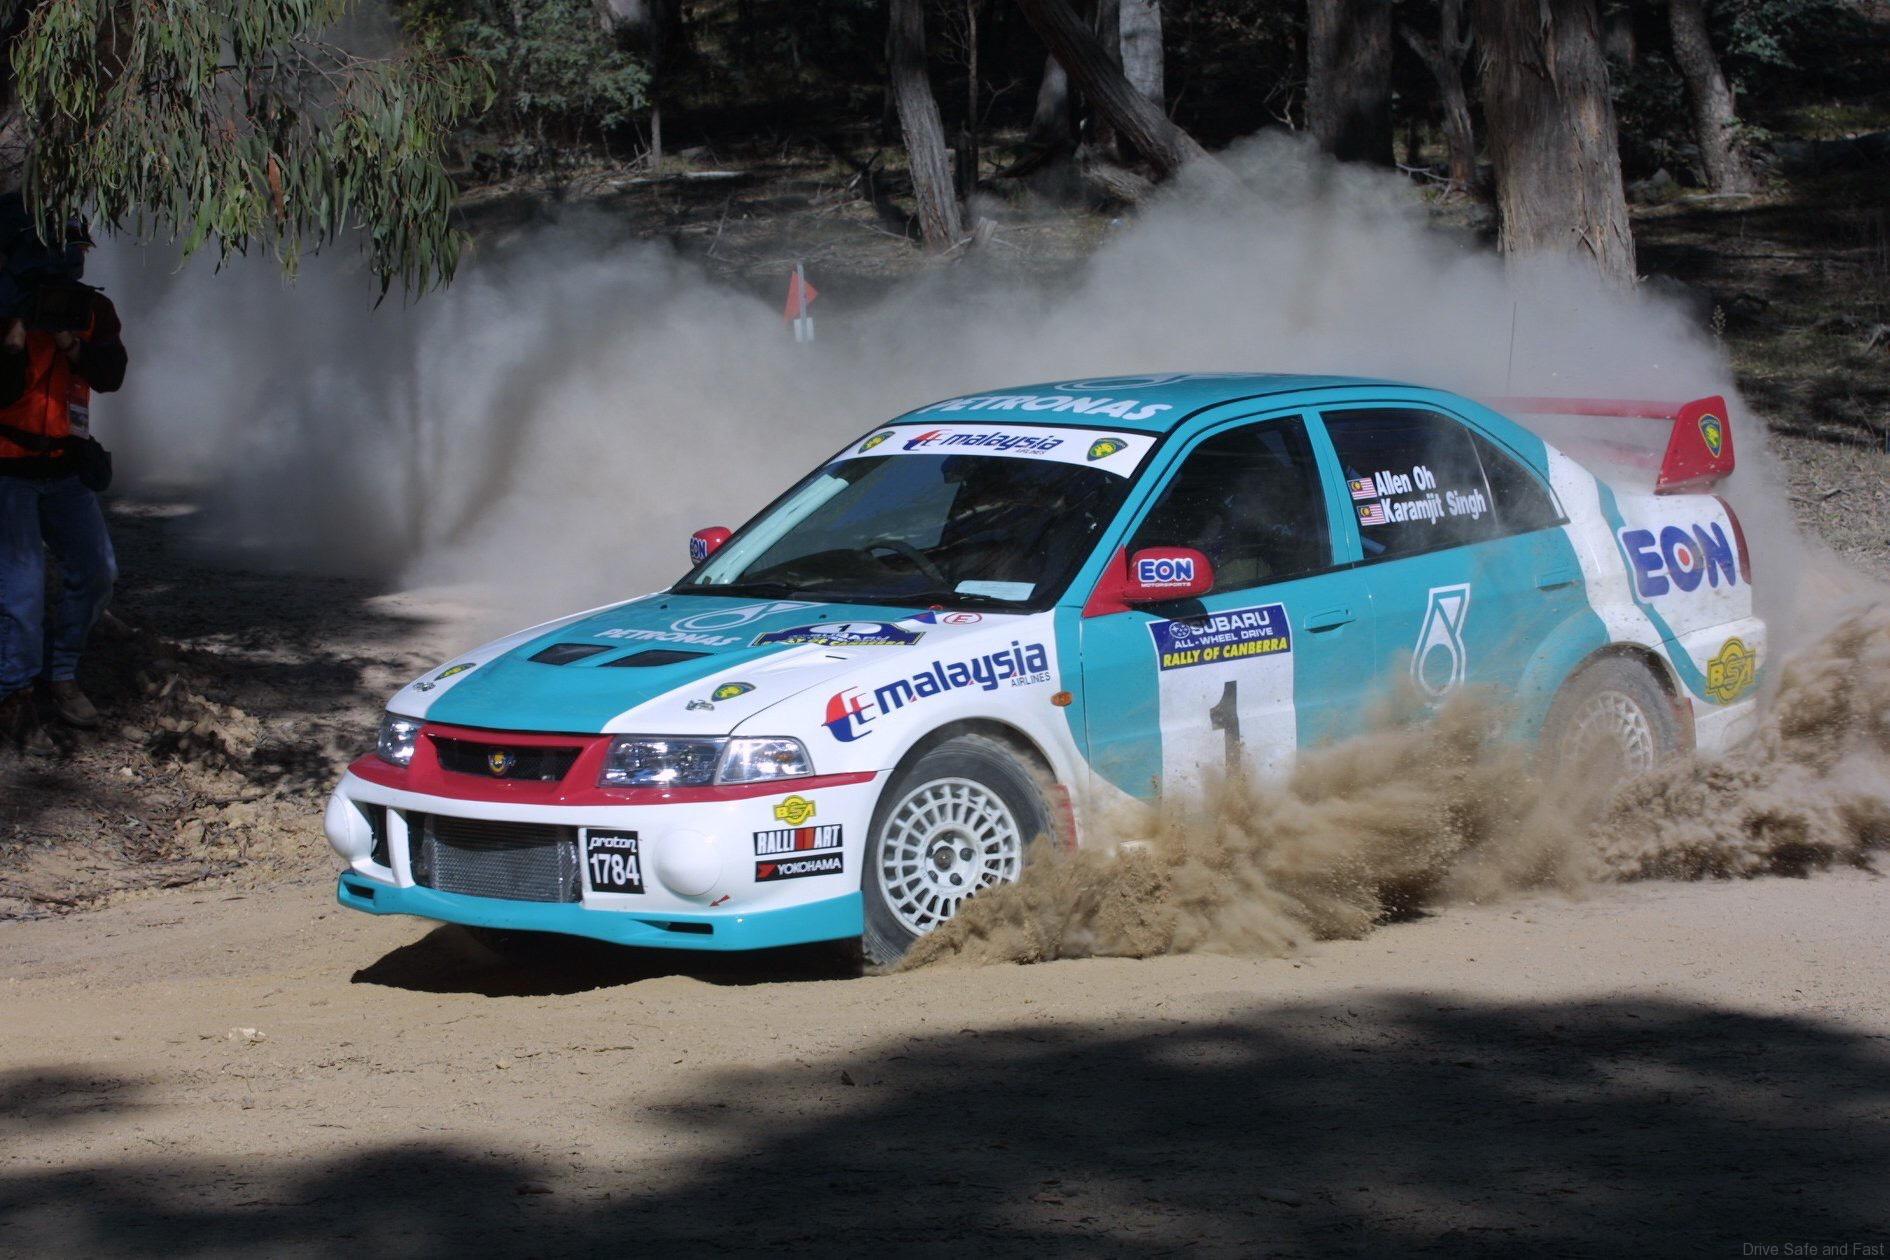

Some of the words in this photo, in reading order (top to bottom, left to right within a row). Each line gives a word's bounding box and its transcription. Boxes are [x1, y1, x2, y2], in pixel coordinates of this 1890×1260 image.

[917, 394, 1173, 420] PETRONAS
[940, 432, 1064, 451] malaysia
[1375, 470, 1412, 496] Allen
[1412, 465, 1437, 491] Oh
[1380, 493, 1445, 525] Karamjit
[1445, 489, 1487, 520] Singh
[1139, 559, 1194, 582] EON
[1622, 521, 1737, 598] EON
[1190, 610, 1270, 635] SUBARU
[1241, 627, 1274, 639] DRIVE
[593, 628, 742, 647] PETRONAS
[1163, 649, 1200, 668] RALLY
[1203, 647, 1220, 662] OF
[1222, 637, 1288, 659] CANBERRA
[874, 640, 1048, 715] malaysia
[1010, 671, 1051, 688] AIRLINES
[1209, 680, 1241, 776] 1
[588, 836, 636, 851] proton
[590, 853, 640, 886] 1784
[777, 857, 842, 875] YOKOHAMA
